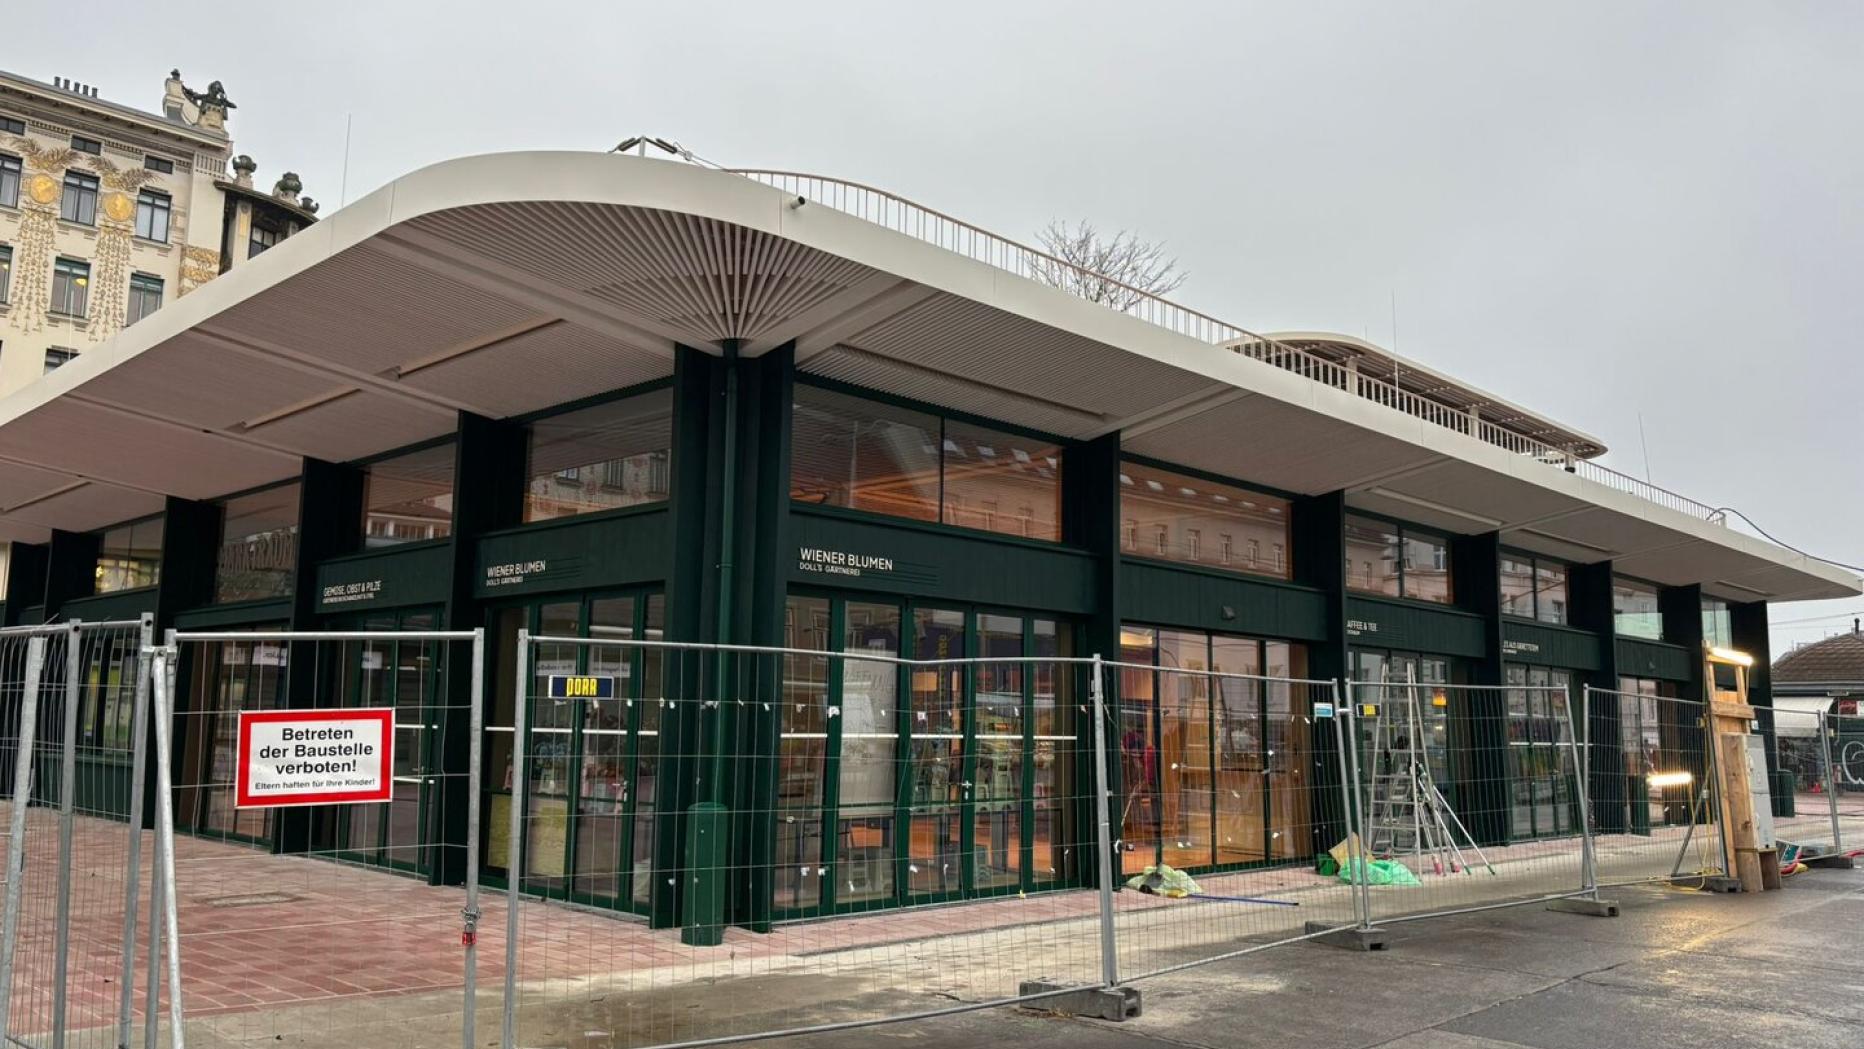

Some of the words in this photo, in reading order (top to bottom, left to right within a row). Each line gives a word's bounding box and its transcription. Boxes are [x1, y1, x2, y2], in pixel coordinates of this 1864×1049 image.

[800, 547, 845, 565] WIENER
[847, 554, 893, 571] BLUMEN
[487, 564, 514, 578] WIENER
[515, 560, 546, 574] BLUMEN
[282, 727, 354, 741] Betreten
[259, 745, 289, 759] der
[294, 742, 374, 757] Baustelle
[275, 759, 357, 775] verboten!
[254, 781, 281, 790] Eltern
[282, 779, 311, 789] haften
[312, 778, 325, 788] für
[325, 777, 343, 787] Ihre
[345, 778, 376, 786] Kinder!
